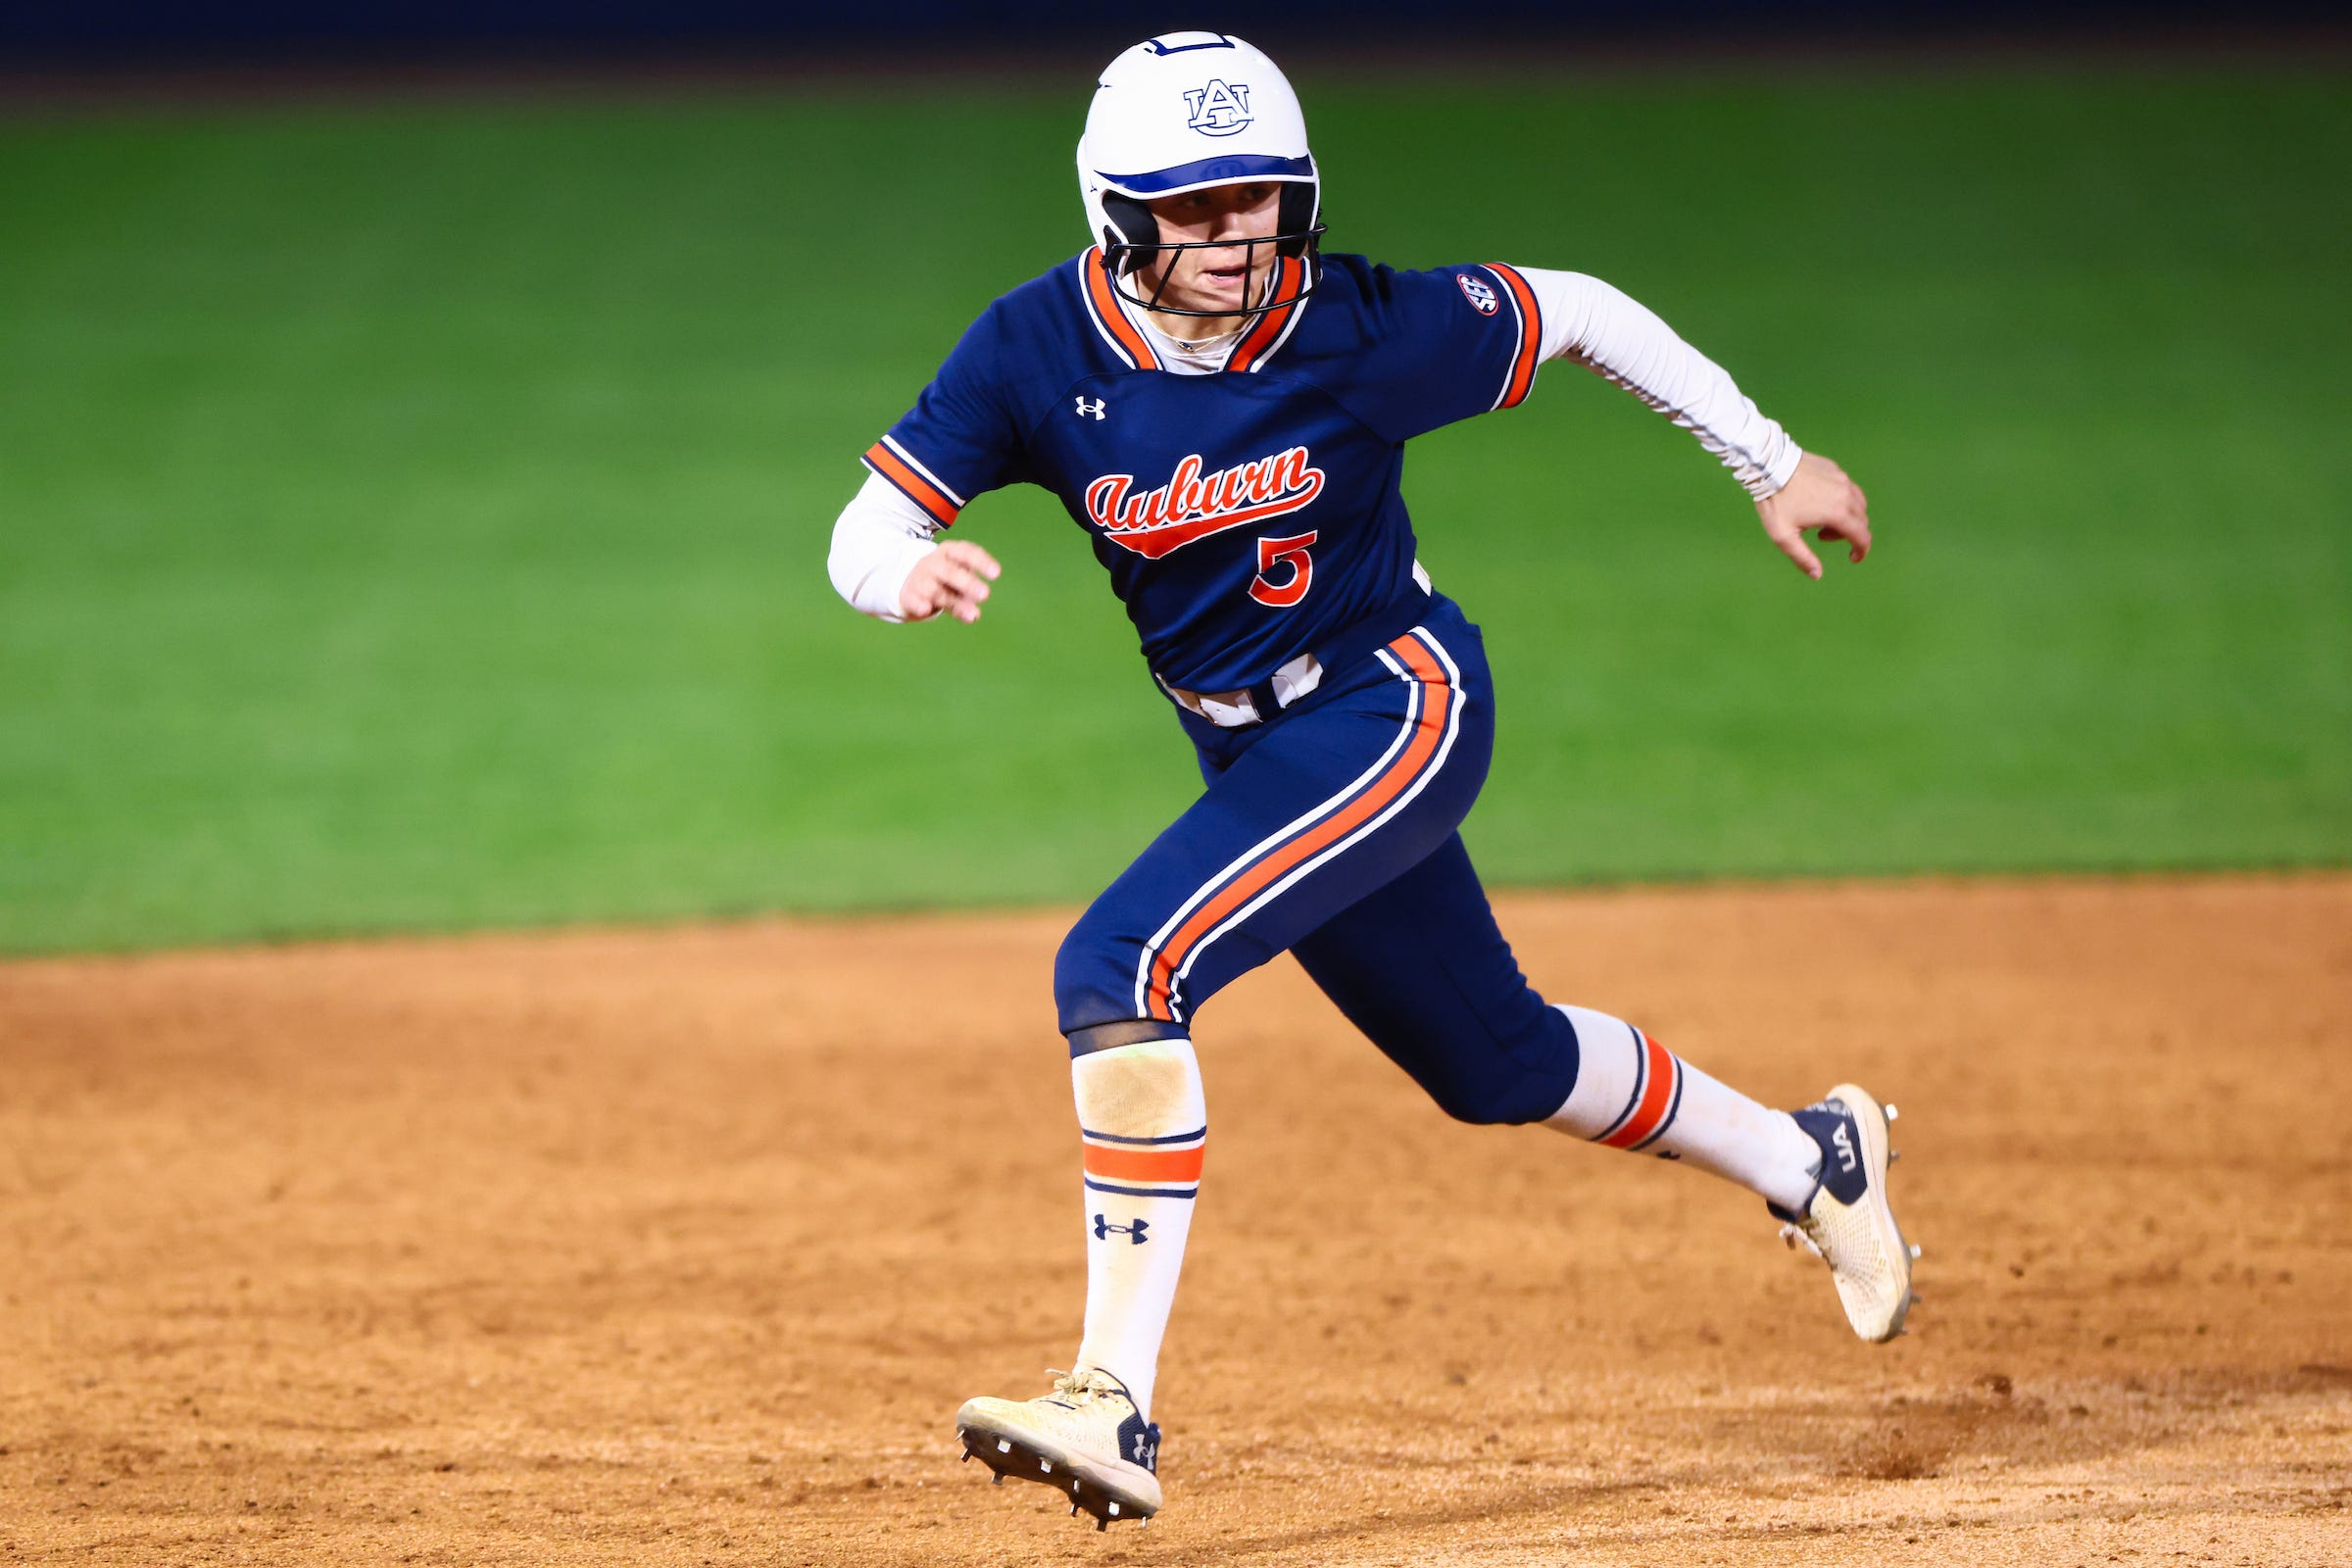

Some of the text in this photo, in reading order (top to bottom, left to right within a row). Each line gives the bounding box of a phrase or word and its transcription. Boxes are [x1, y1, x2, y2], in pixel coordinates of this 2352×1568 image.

[1085, 446, 1326, 560] Auburn
[1248, 529, 1318, 608] 5
[1832, 1120, 1857, 1174] UA
